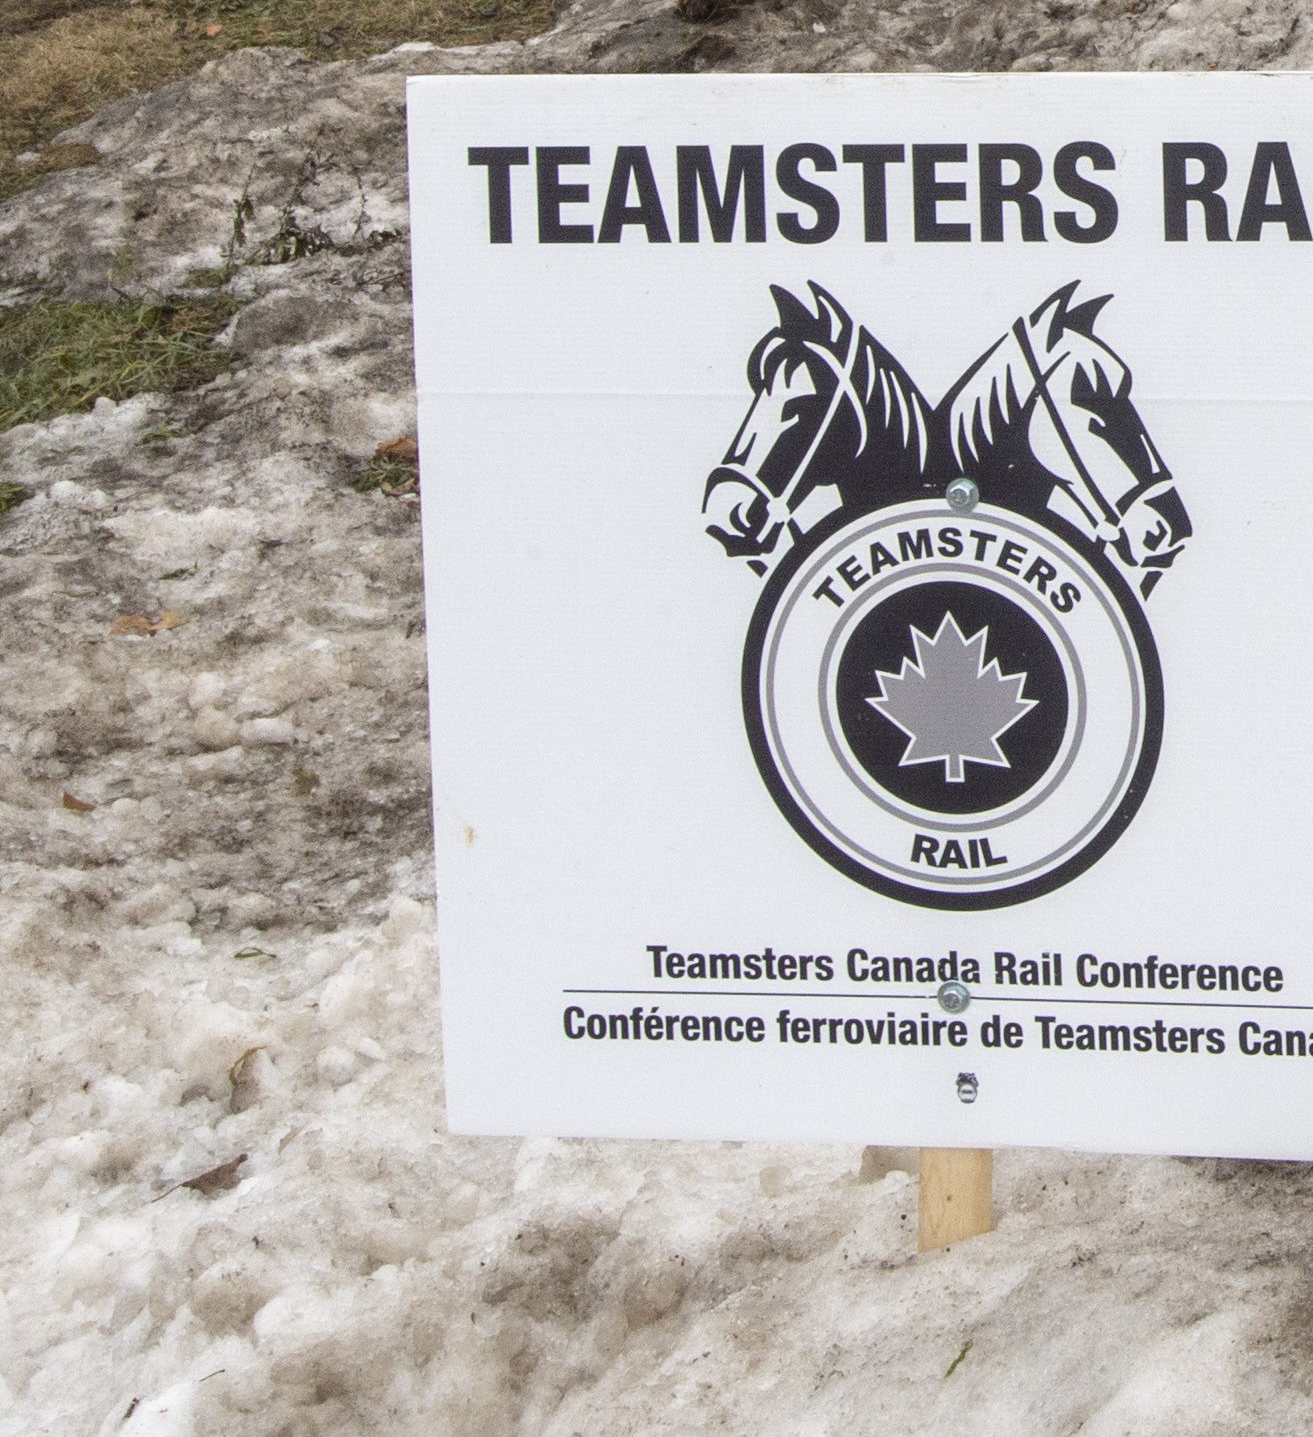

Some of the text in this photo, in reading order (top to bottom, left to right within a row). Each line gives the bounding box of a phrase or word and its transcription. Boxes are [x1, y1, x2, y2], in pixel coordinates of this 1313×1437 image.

[468, 142, 1118, 244] TEAMSTERS
[813, 528, 1080, 612] TEAMSTERS
[911, 834, 1007, 869] RAIL
[647, 946, 1283, 992] Teamsters Canada Rail Conference
[564, 1007, 764, 1042] Conférence
[777, 1010, 967, 1046] ferroviaire
[981, 1015, 1023, 1048] de
[1035, 1016, 1225, 1054] Teamsters
